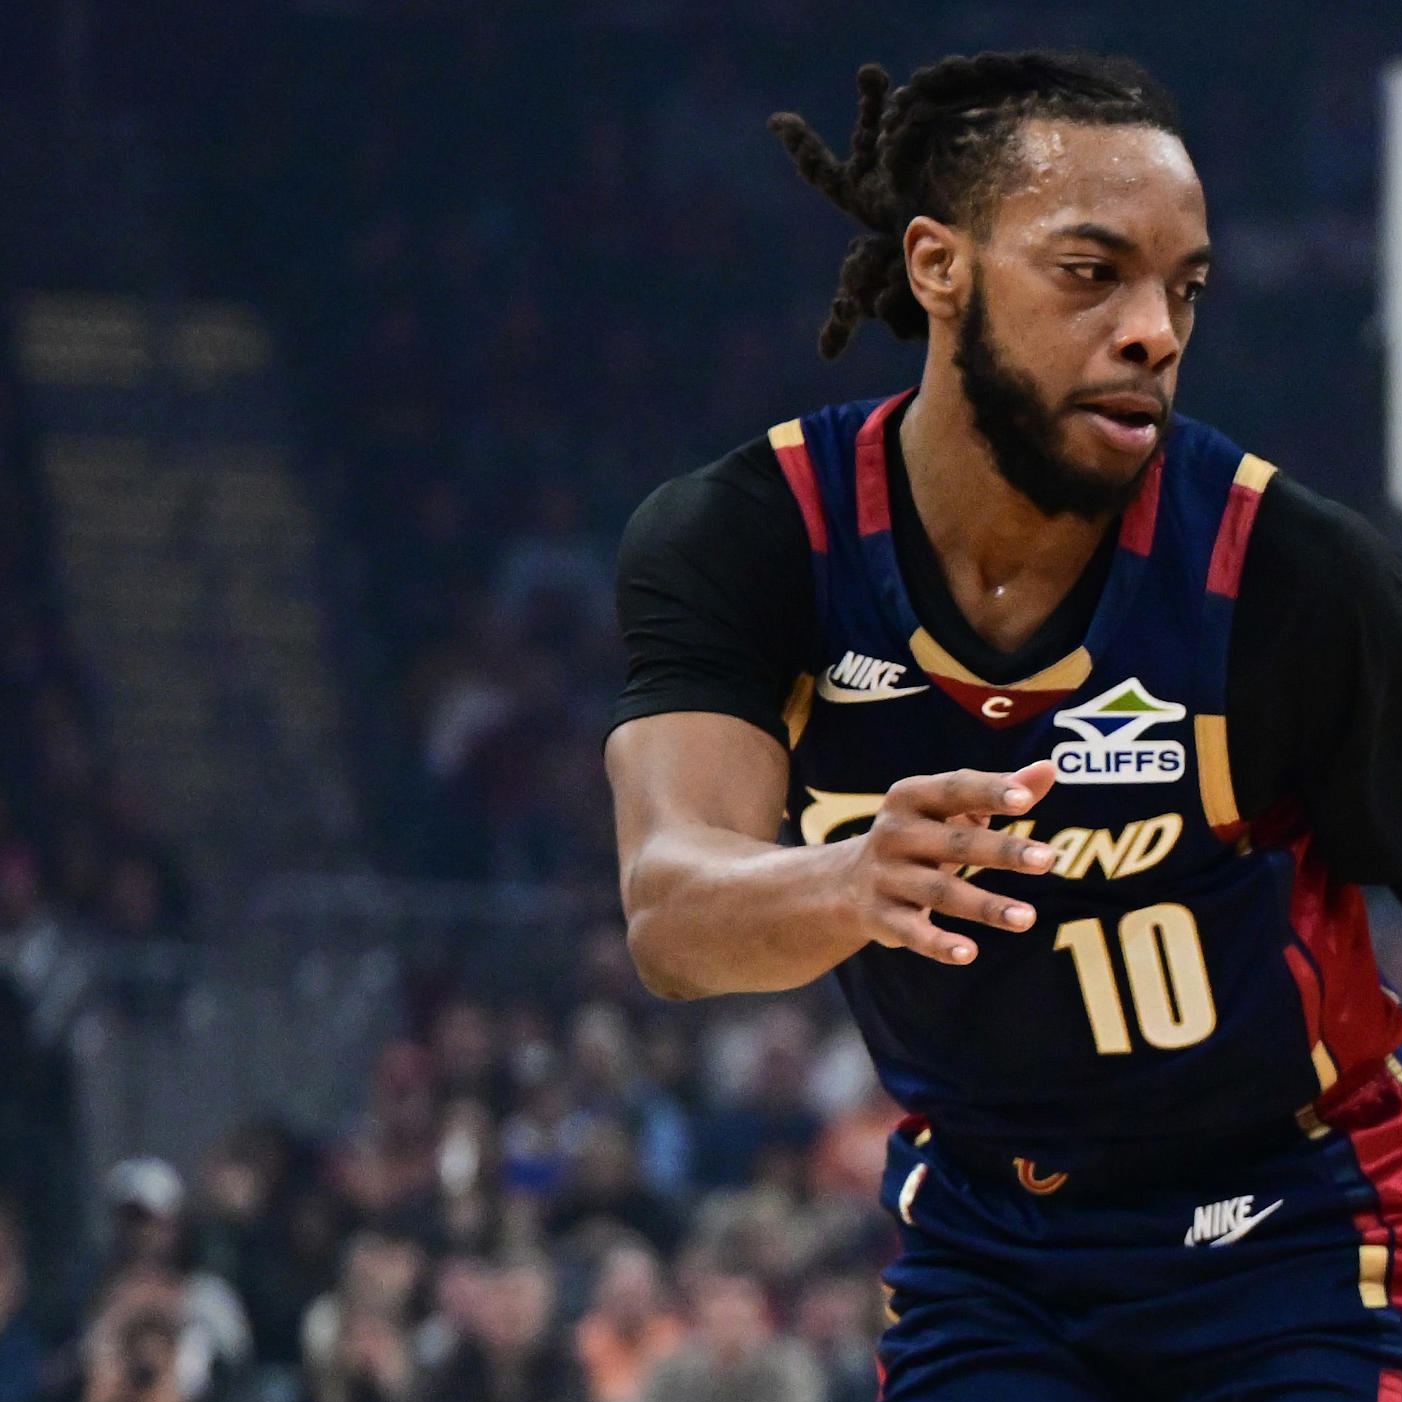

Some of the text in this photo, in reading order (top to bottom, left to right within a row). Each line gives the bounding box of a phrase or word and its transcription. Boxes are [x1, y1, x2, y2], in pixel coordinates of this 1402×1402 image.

[833, 650, 908, 690] NIKE
[1057, 750, 1182, 774] CLIFFS
[1053, 904, 1217, 1054] 10
[1192, 1194, 1255, 1240] NIKE
